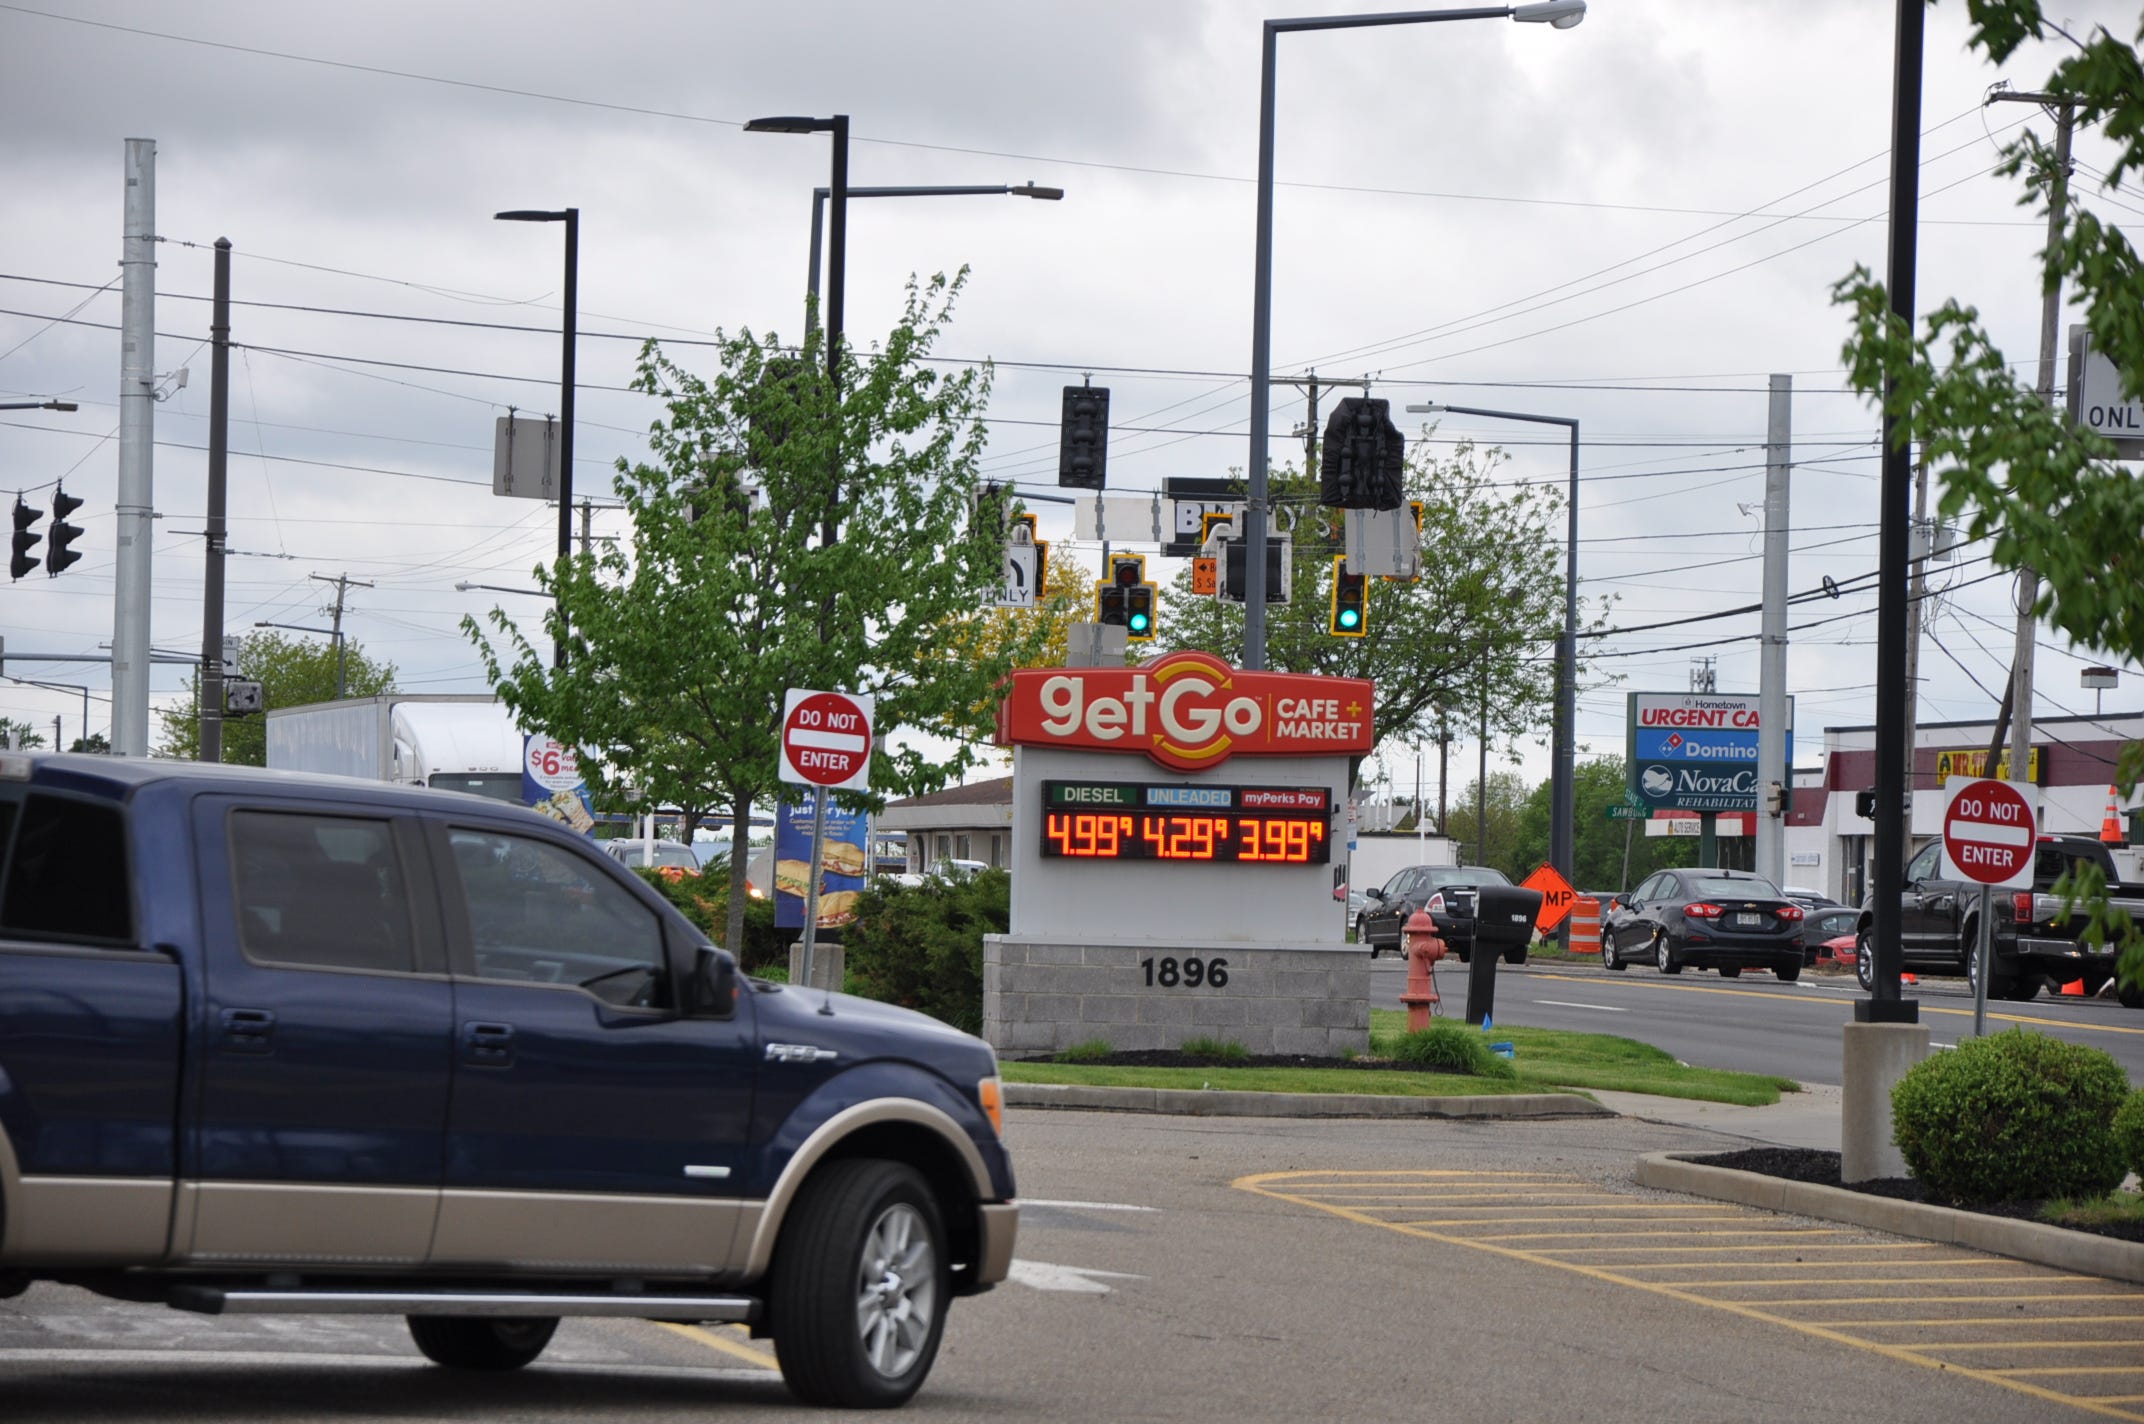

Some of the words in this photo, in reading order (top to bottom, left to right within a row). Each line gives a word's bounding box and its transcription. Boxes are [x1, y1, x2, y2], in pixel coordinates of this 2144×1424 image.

[2088, 405, 2144, 429] ONL
[1040, 674, 1262, 743] getGo
[1276, 698, 1339, 720] CAFE
[1695, 699, 1746, 710] Hometown
[799, 708, 821, 727] DO
[827, 712, 858, 730] NOT
[1641, 708, 1728, 726] URGENT
[1732, 710, 1760, 727] CA
[1276, 722, 1362, 740] MARKET
[1686, 742, 1760, 758] Domino'
[531, 749, 560, 776] $6
[800, 750, 850, 771] ENTER
[1675, 769, 1758, 793] NovaCa
[1064, 787, 1124, 804] DIESEL
[1147, 788, 1232, 806] UNLEADED
[1245, 792, 1296, 806] myPerks
[1299, 793, 1321, 807] Pay
[1677, 797, 1758, 809] REHABILITAT
[789, 804, 814, 817] just
[1960, 798, 1983, 818] DO
[1989, 802, 2021, 822] NOT
[1962, 845, 2014, 868] ENTER
[1545, 890, 1573, 907] MP
[1511, 914, 1527, 923] 1896
[1141, 957, 1228, 988] 1896
